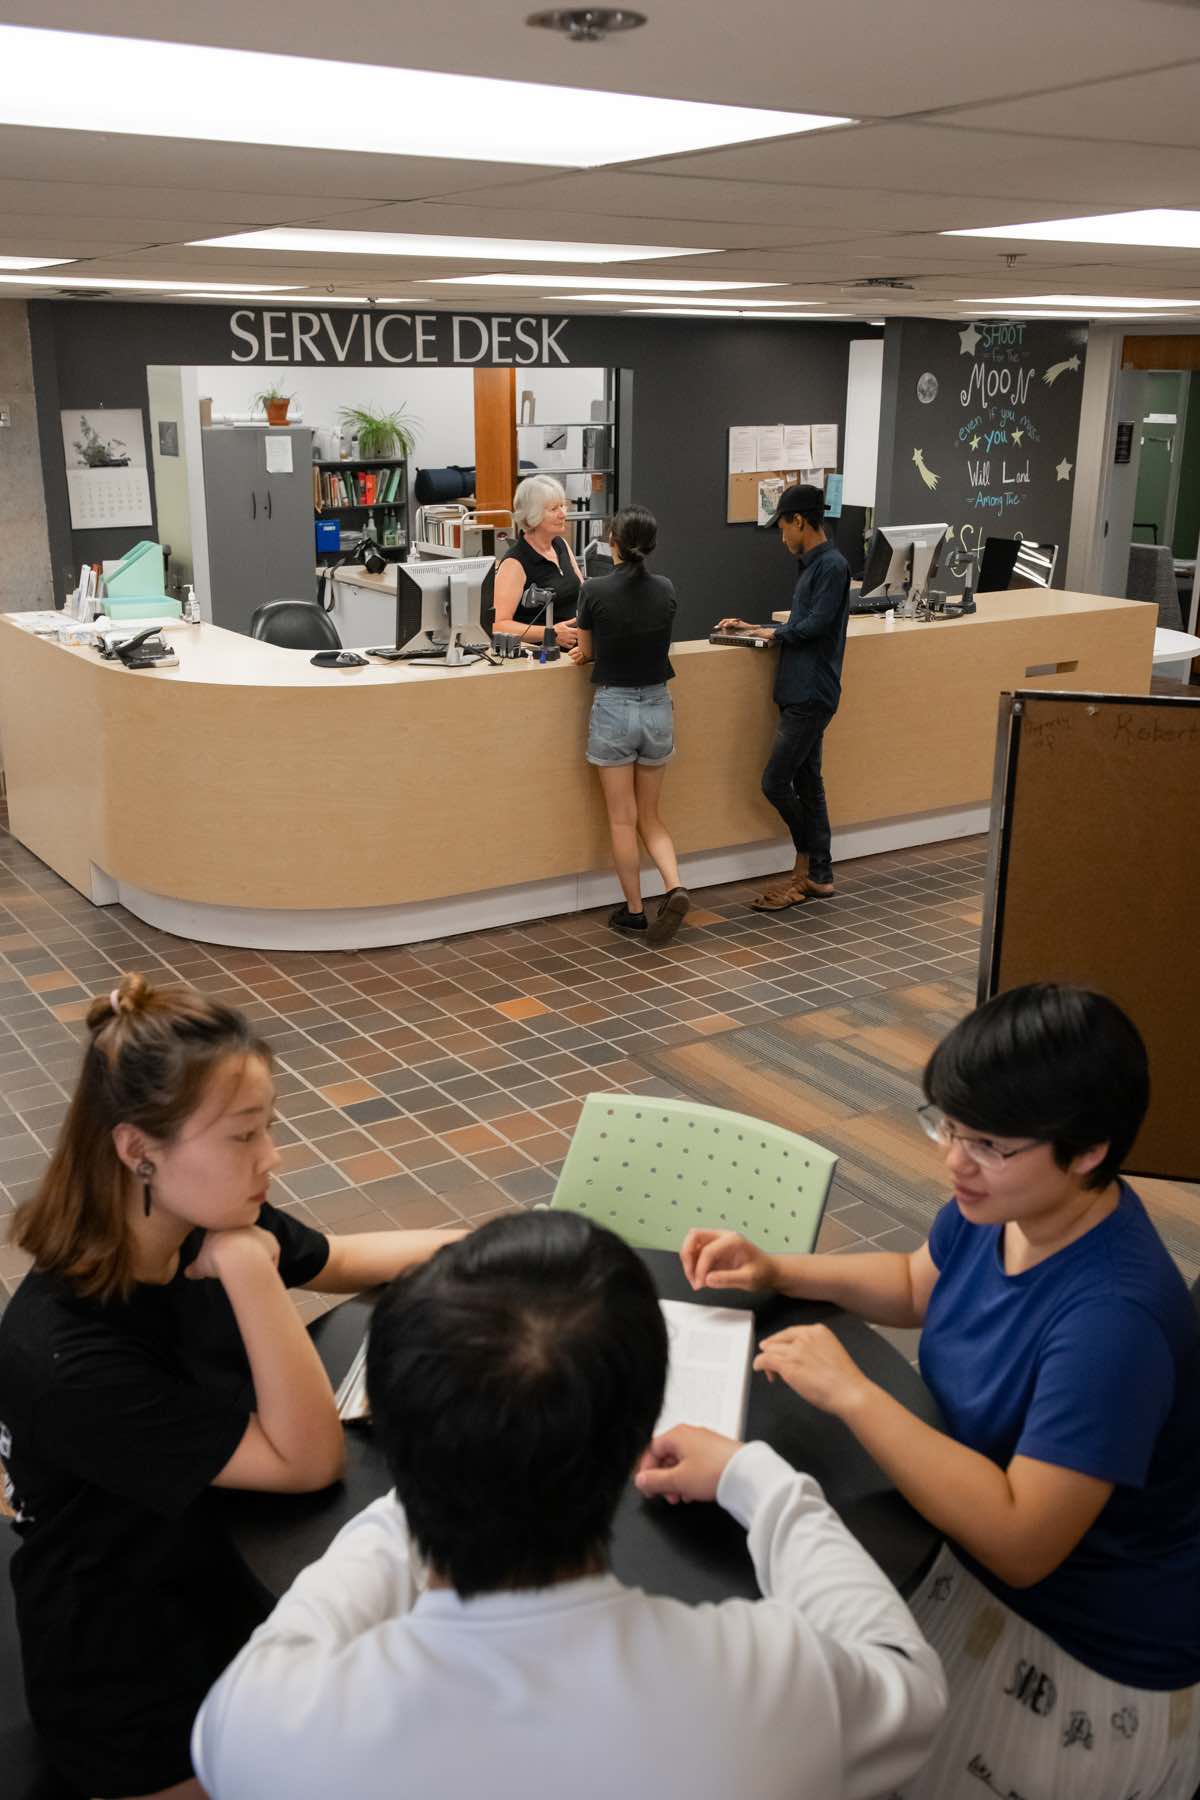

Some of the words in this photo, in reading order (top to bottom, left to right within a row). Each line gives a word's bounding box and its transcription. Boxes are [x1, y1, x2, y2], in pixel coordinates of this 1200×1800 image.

[230, 310, 438, 363] SERVICE
[452, 315, 570, 364] DESK
[982, 325, 1027, 348] SHOOT
[958, 415, 983, 441] even
[1000, 408, 1015, 428] you
[984, 430, 1008, 453] you
[967, 460, 990, 487] Will
[1002, 459, 1030, 483] Land
[975, 491, 1003, 516] Among
